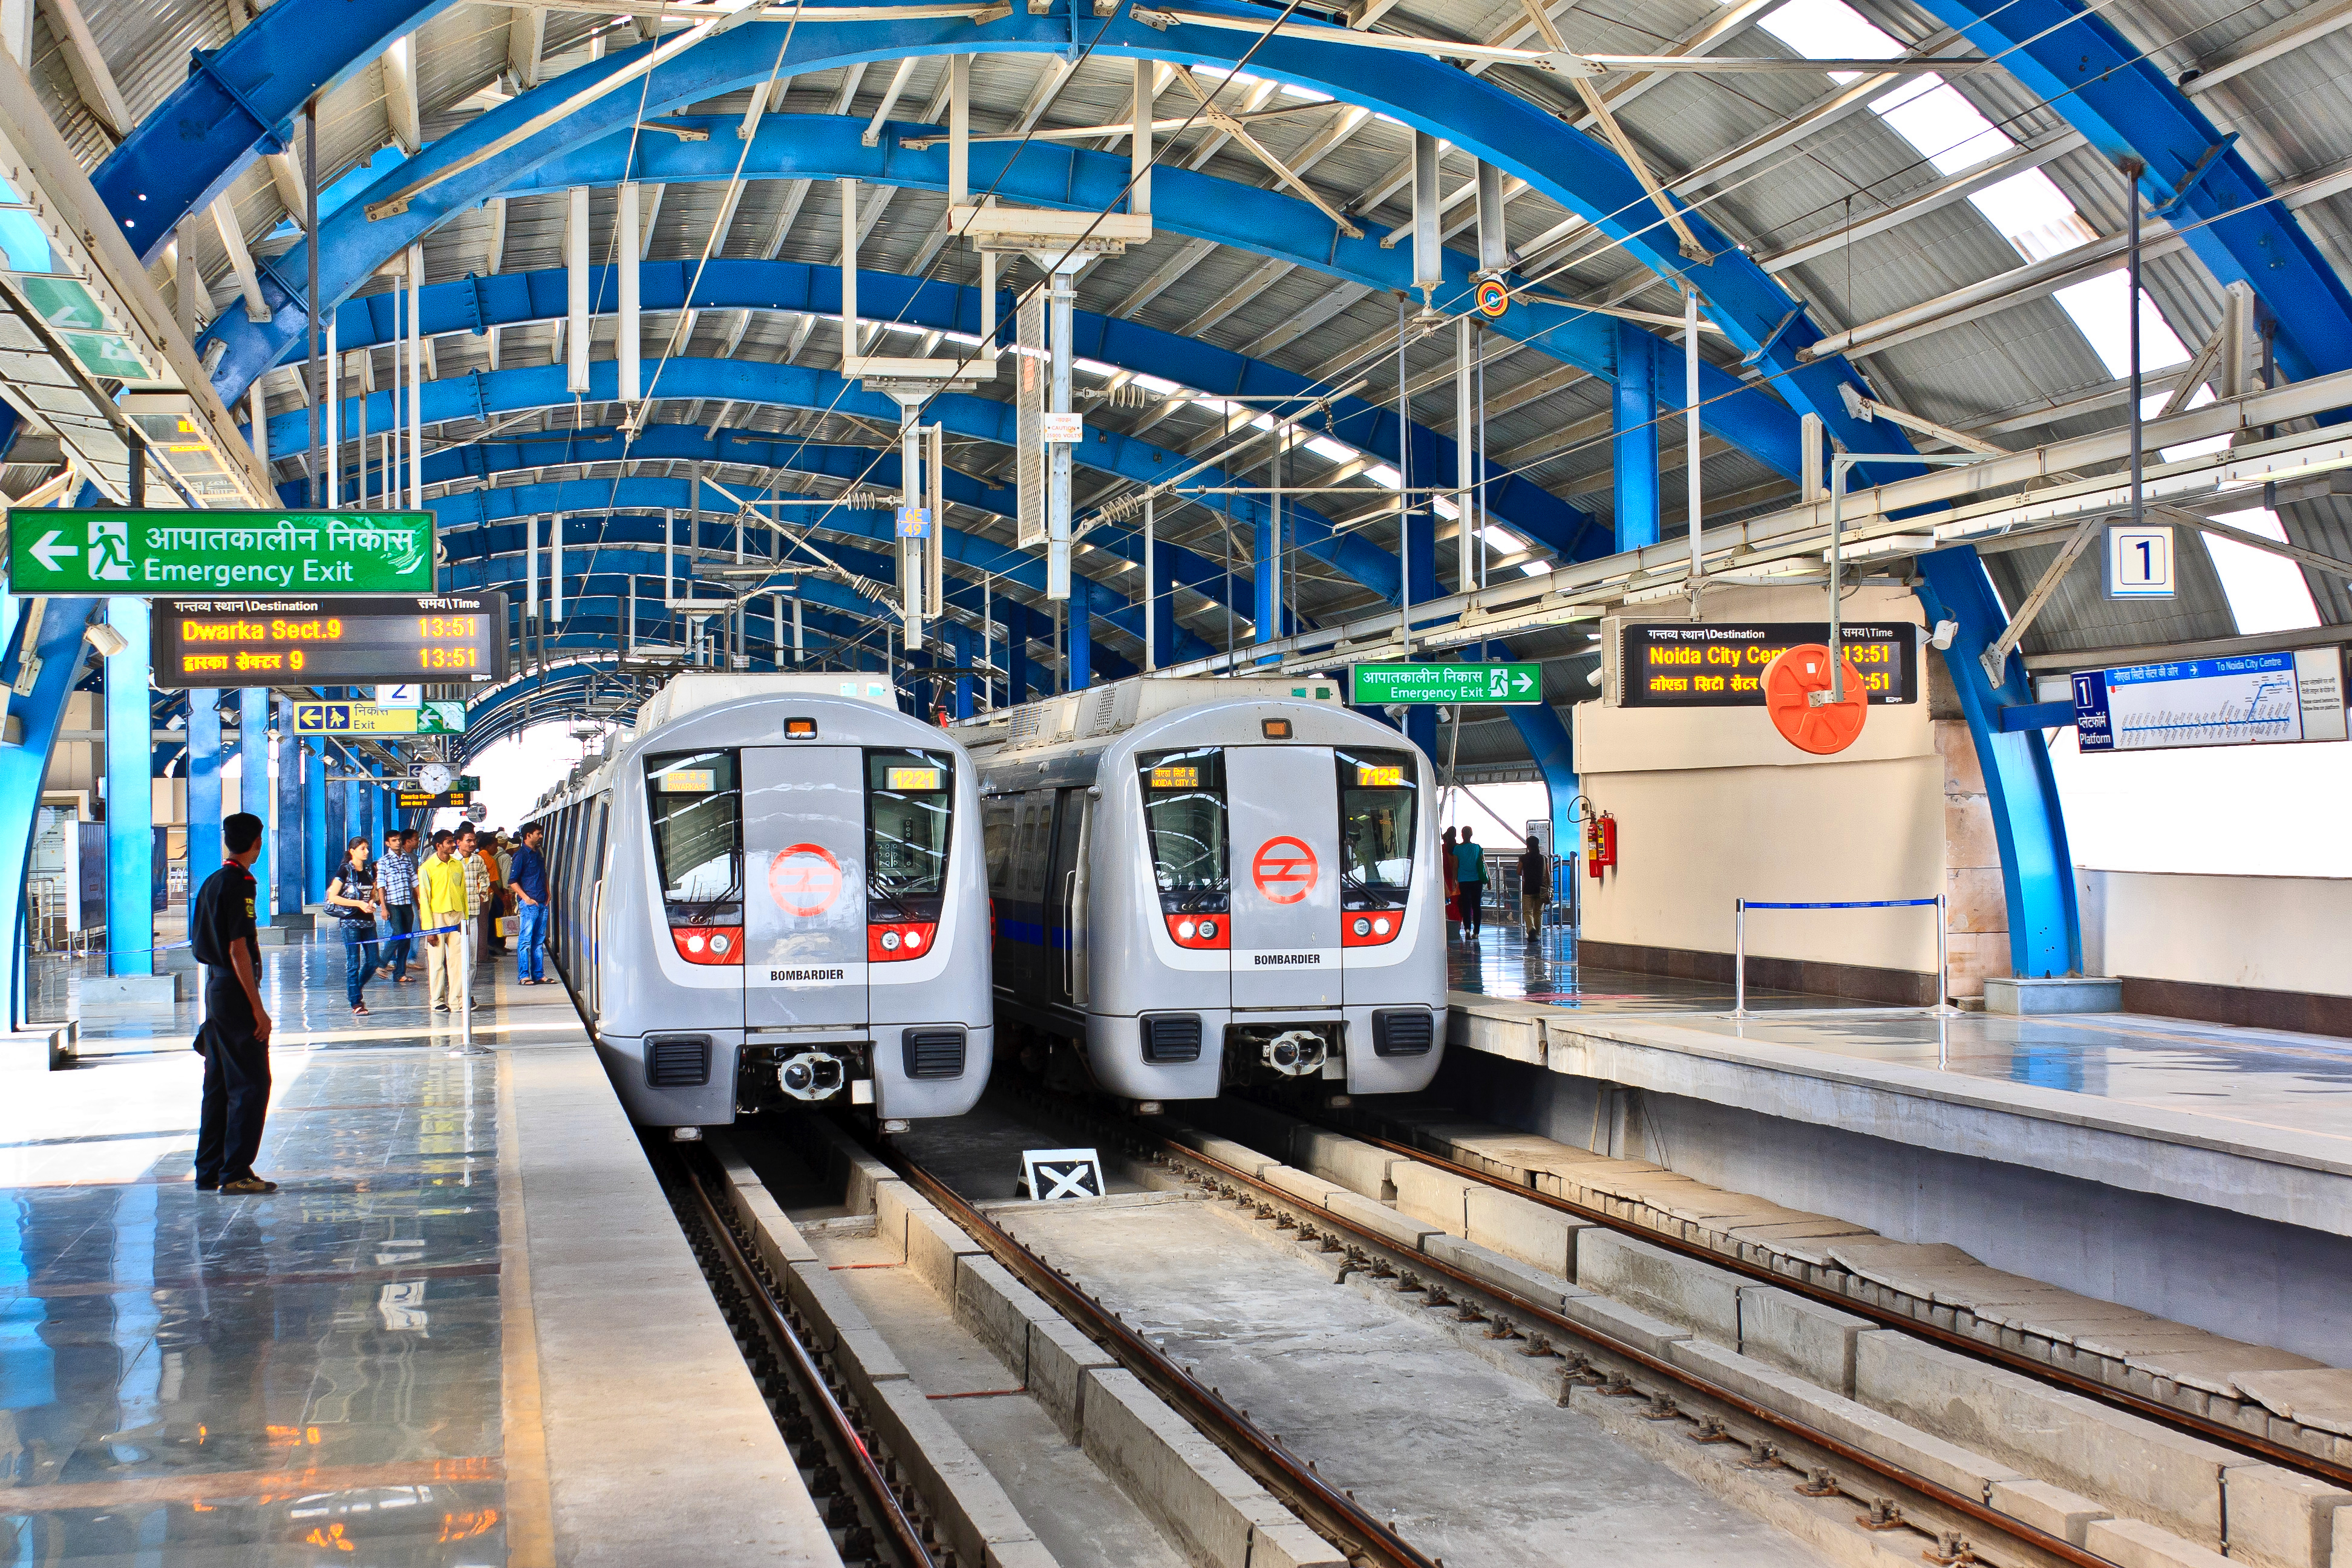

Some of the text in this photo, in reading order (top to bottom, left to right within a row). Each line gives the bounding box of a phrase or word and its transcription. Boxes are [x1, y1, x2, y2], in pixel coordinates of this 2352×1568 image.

[905, 509, 923, 521] 6E
[146, 520, 416, 552] आपातकालीन निकास
[904, 523, 921, 536] 49
[2135, 540, 2151, 580] 1
[144, 558, 354, 587] Emergency Exit
[174, 601, 211, 612] गन्तव्य
[183, 619, 341, 641] Dwarka Sect.9
[419, 617, 475, 637] 13:51
[1647, 630, 1678, 639] गन्तव्य
[183, 650, 304, 671] द्वारका सेक्टर 9
[420, 647, 477, 667] 13:51
[1650, 646, 1702, 664] Noida
[1707, 645, 1742, 667] City
[1843, 645, 1889, 662] 13:51
[2216, 657, 2282, 671] To Noida City Centre
[1362, 667, 1483, 684] आपातकालीन निकास
[2114, 669, 2131, 682] नोएडा
[2131, 667, 2145, 680] सिटी
[2158, 665, 2166, 676] की
[1650, 675, 1688, 691] नोएडा
[1693, 676, 1725, 692] सिटी
[1390, 686, 1484, 701] Emergency Exit
[2079, 681, 2088, 705] 1
[354, 720, 376, 730] Exit
[2077, 711, 2106, 728] प्लेटफॉर्म
[2079, 733, 2111, 745] Platform
[893, 769, 935, 789] 1221
[1154, 767, 1171, 777] नोएडा
[1173, 766, 1186, 777] सिटी
[1359, 768, 1400, 786] 7128
[667, 782, 707, 791] DWARKA-9
[1254, 954, 1321, 965] BOMBARDIER
[771, 969, 844, 981] BOMBARDIER
